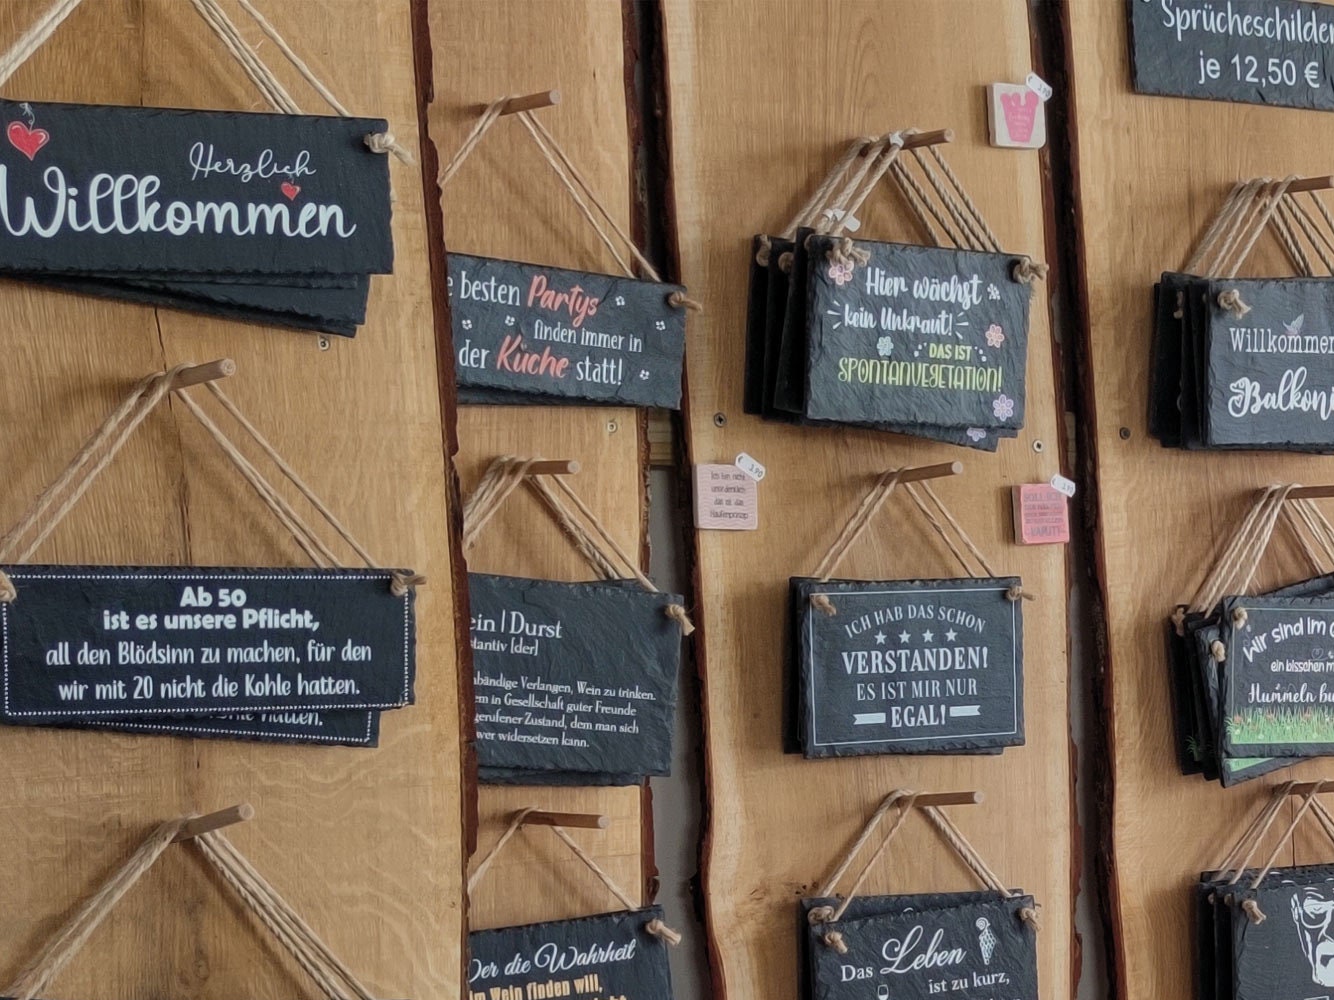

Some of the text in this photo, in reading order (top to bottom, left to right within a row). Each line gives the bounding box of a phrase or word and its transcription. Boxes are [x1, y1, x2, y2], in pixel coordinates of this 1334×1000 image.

[1199, 51, 1320, 88] je 12,50 €
[189, 142, 317, 182] Herzlich
[0, 164, 357, 238] Willkommen
[460, 271, 521, 306] besten
[527, 275, 600, 327] Partys
[866, 267, 983, 310] Hier wächst
[844, 303, 953, 336] kein Unkraut!
[534, 319, 642, 352] finden immer in
[459, 334, 623, 385] der Küche statt!
[929, 344, 974, 361] DAS IST
[838, 357, 1002, 392] SPONTANVEGETATION!
[180, 586, 247, 608] Ab 50
[103, 608, 320, 632] ist es unsere Pflicht,
[510, 611, 562, 638] Durst
[845, 604, 986, 639] ICH HAB DAS SCHON
[46, 639, 372, 666] all den Blödsinn zu machen, für den
[841, 646, 989, 675] VERSTANDEN!
[58, 672, 361, 701] wir mit 20 nicht die Kohle hatten.
[857, 678, 978, 701] ES IST MIR NUR
[1248, 683, 1317, 703] Hummeln
[890, 705, 946, 728] EGAL!
[504, 938, 636, 975] die Wahrheit
[880, 925, 966, 974] Leben
[526, 980, 570, 1000] finden
[574, 973, 603, 994] will,
[841, 965, 873, 982] Das
[929, 972, 1010, 994] ist zu kurz,
